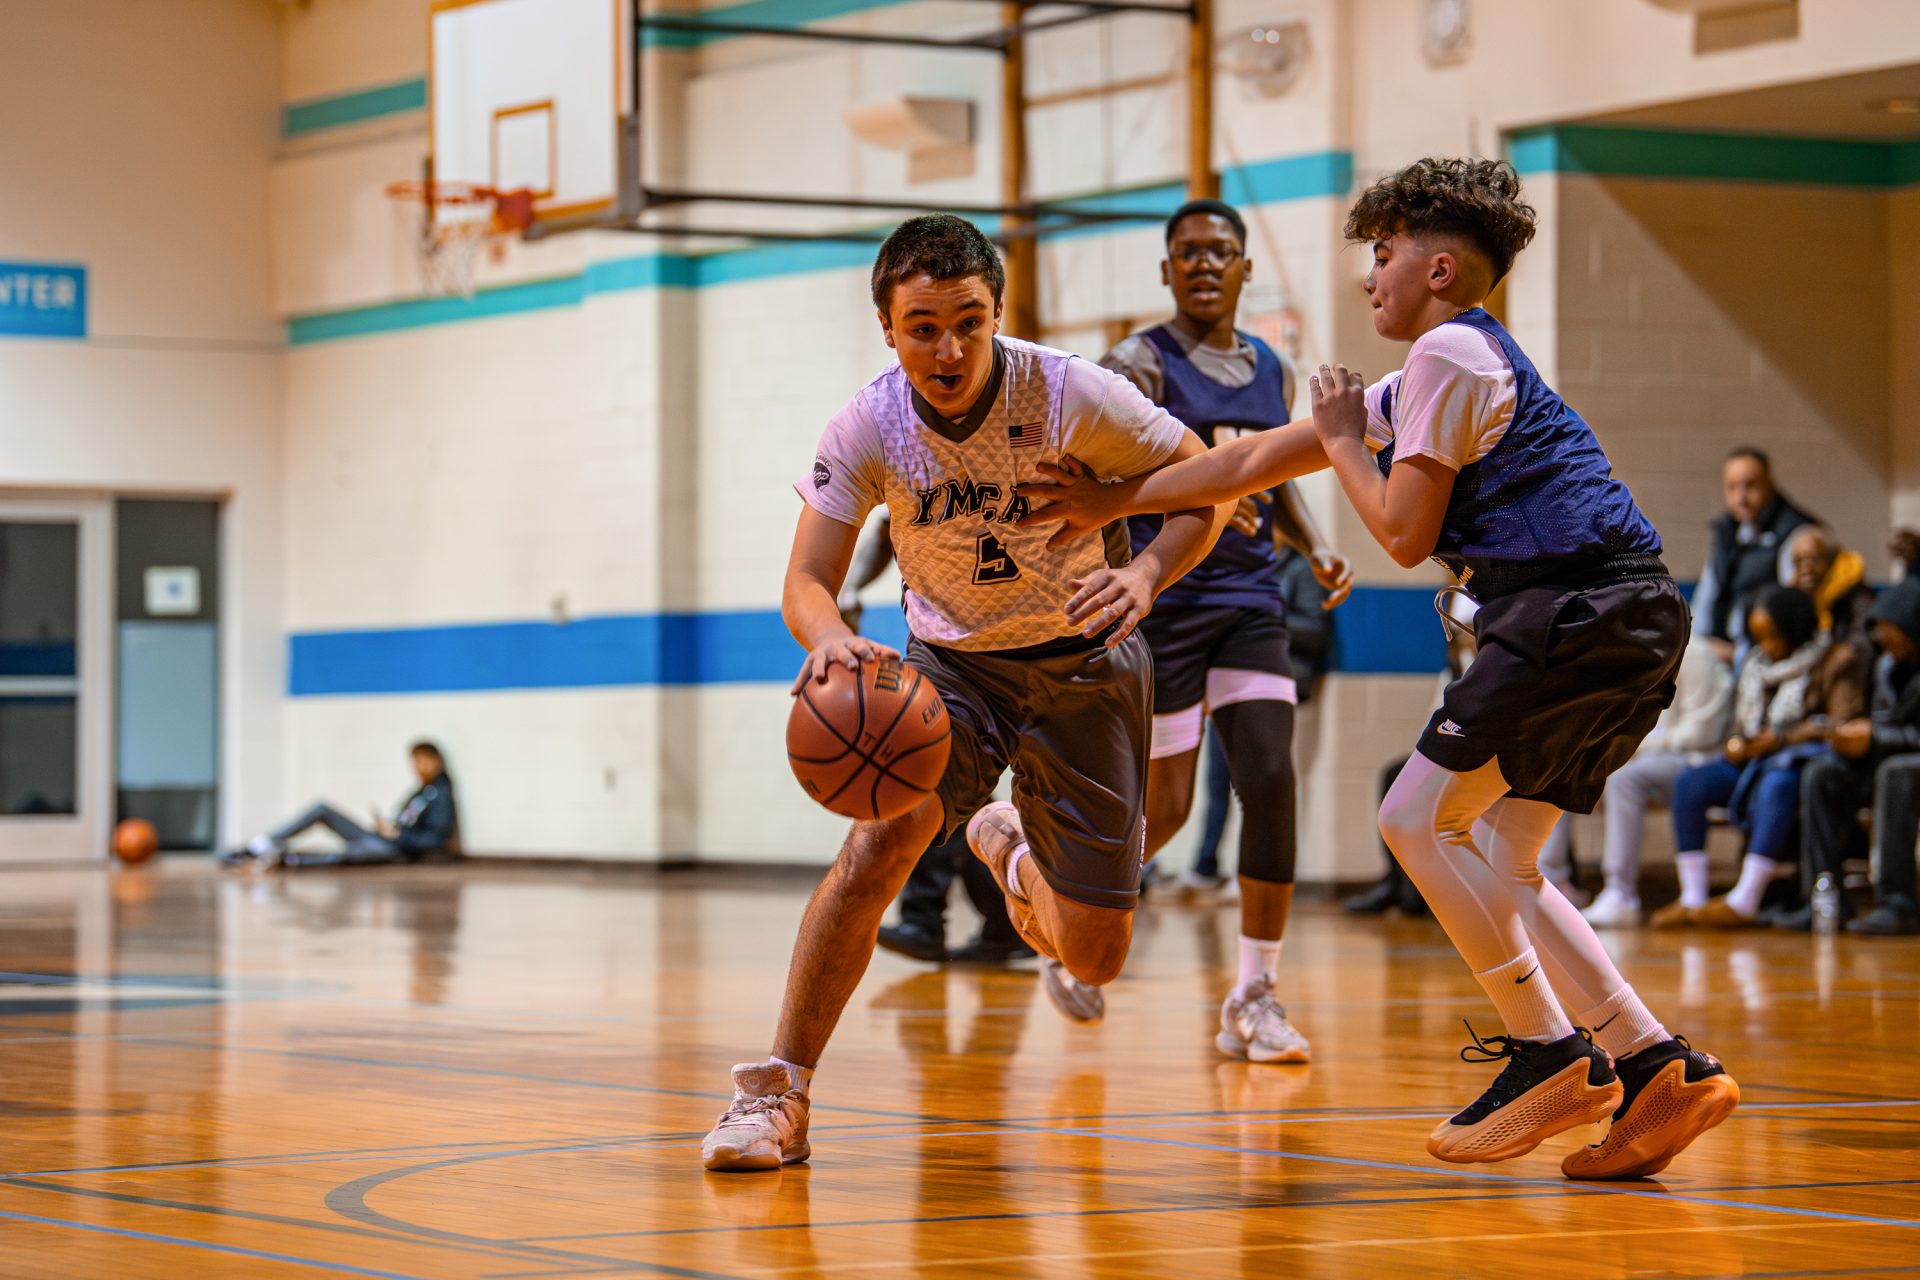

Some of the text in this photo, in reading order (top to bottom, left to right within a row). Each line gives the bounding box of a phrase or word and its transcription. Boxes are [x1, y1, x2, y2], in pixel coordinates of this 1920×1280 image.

[911, 477, 1032, 526] YMCA
[972, 531, 1022, 585] 5
[1441, 718, 1461, 735] NIKE
